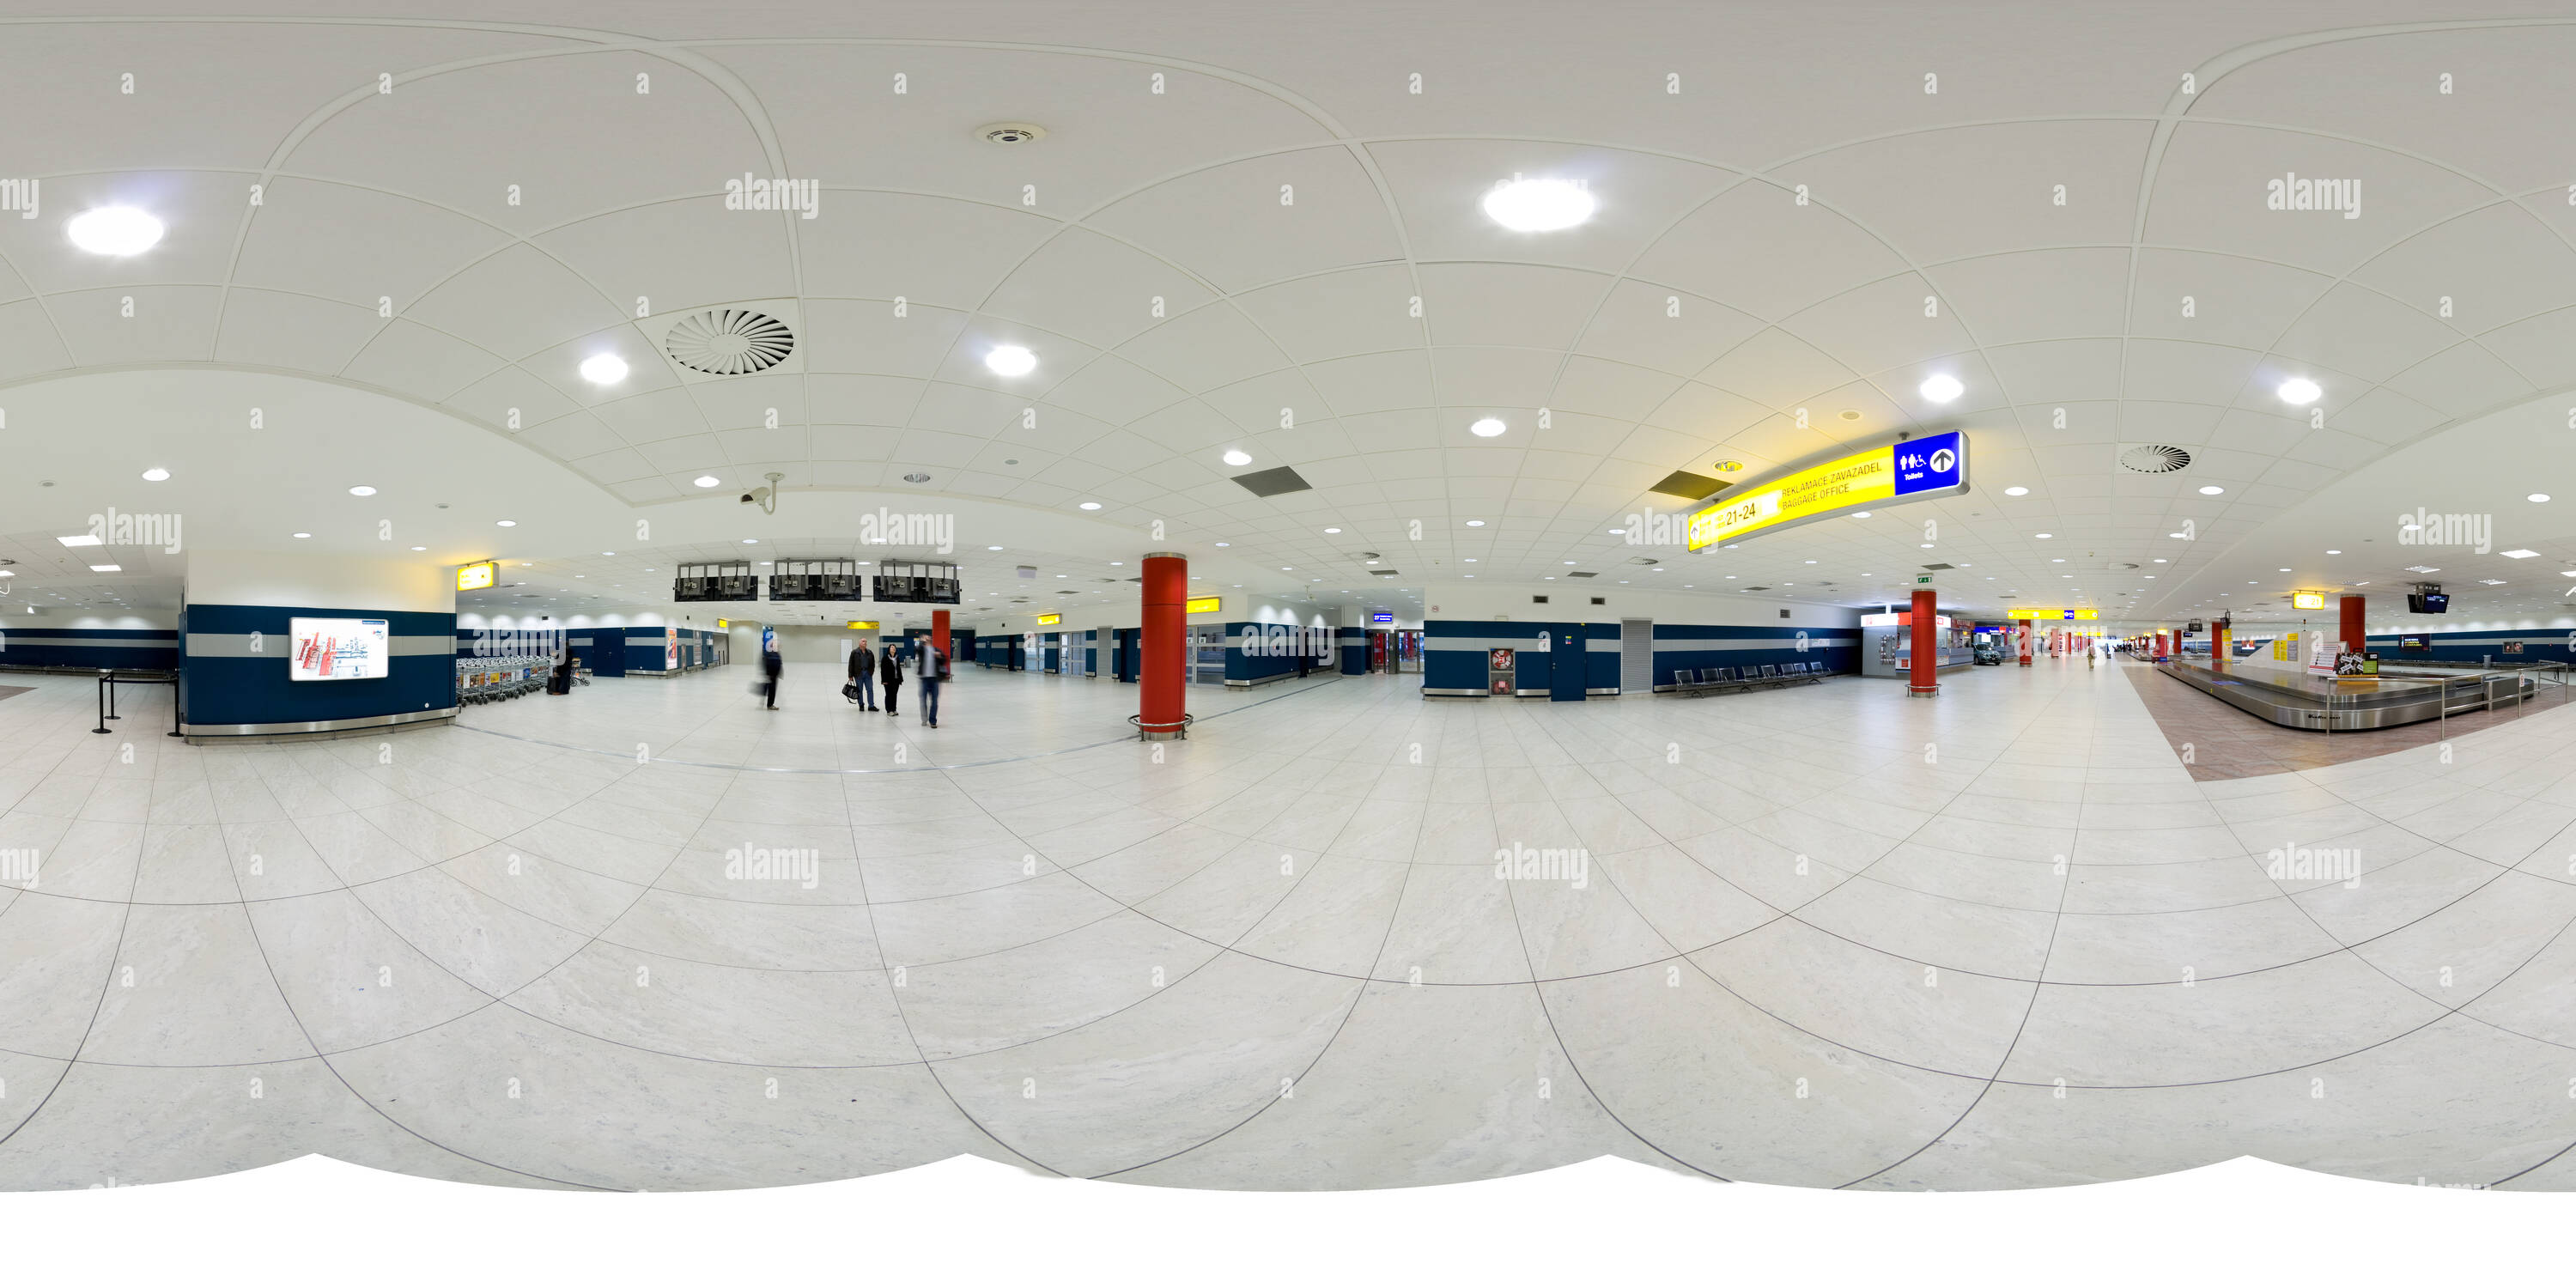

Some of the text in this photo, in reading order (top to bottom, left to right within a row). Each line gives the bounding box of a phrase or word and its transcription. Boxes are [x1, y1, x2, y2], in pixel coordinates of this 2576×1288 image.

[1783, 462, 1882, 497] REKLAMACE ZAVAZADEL
[1904, 471, 1923, 481] Toilets
[1783, 483, 1850, 510] BAGGAGE OFFICE
[1726, 502, 1756, 526] 21-24
